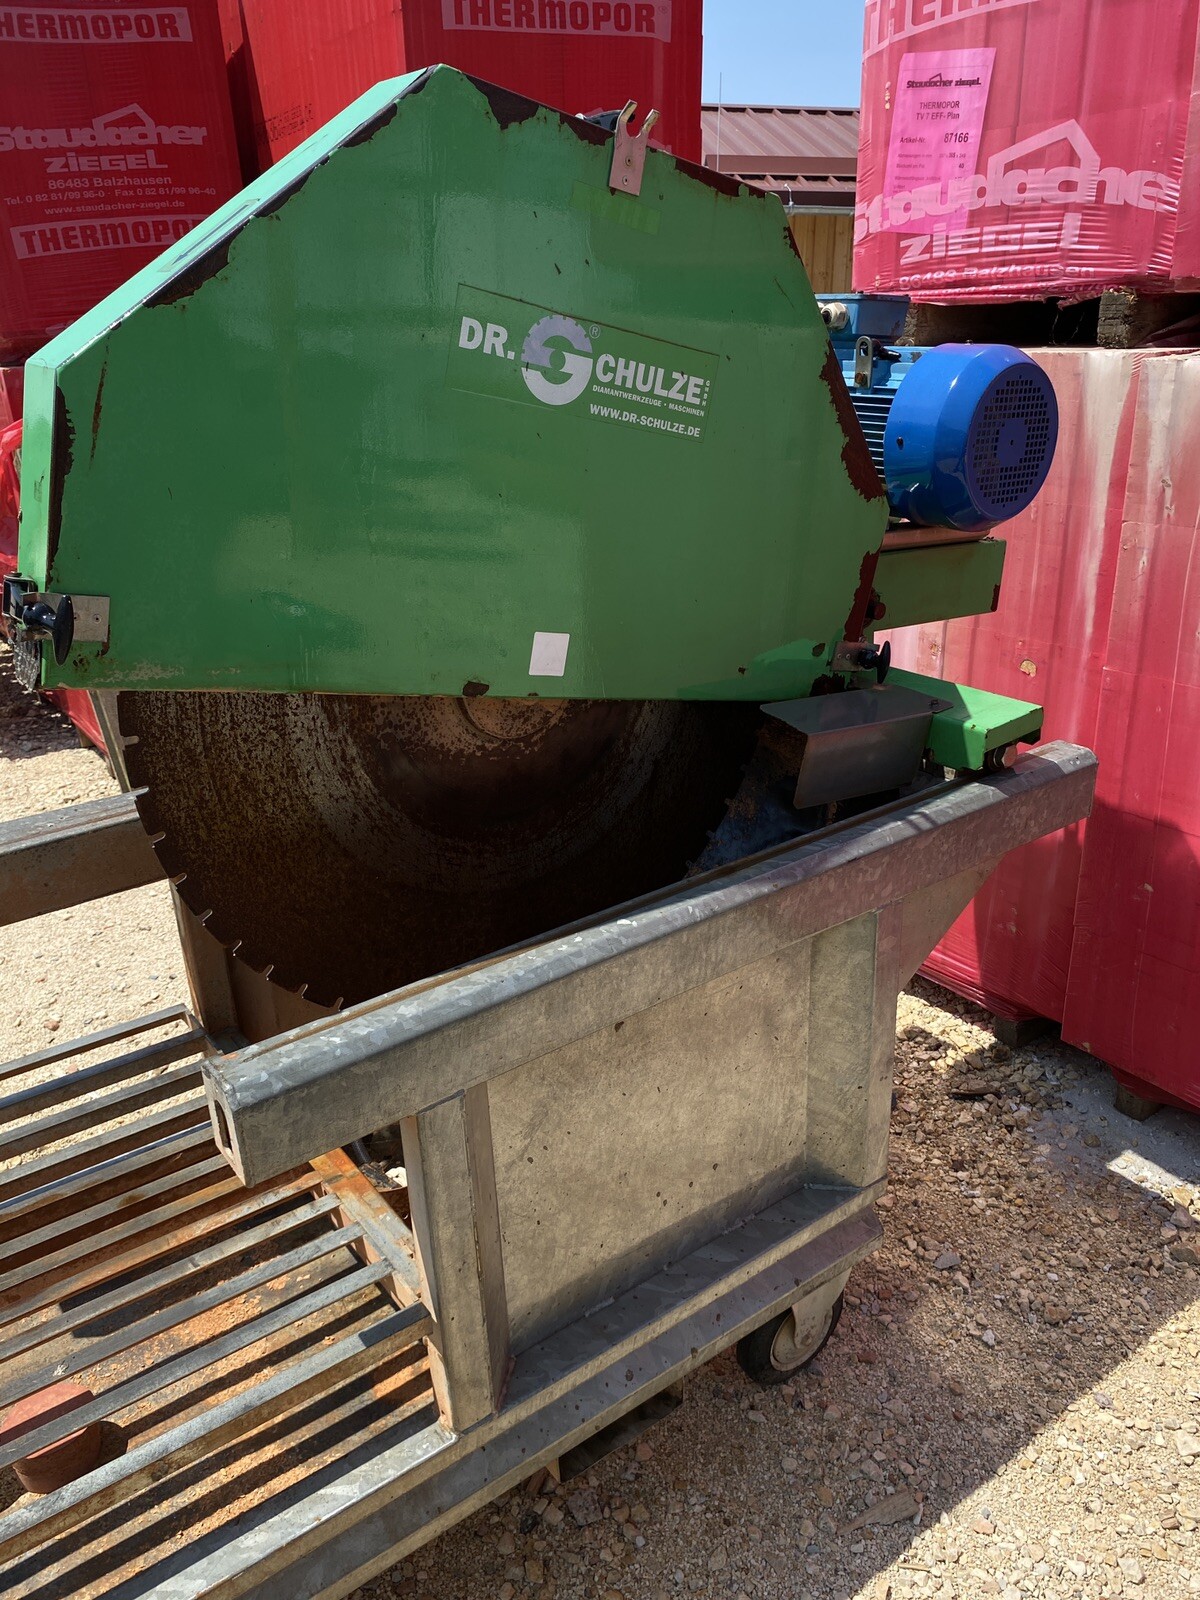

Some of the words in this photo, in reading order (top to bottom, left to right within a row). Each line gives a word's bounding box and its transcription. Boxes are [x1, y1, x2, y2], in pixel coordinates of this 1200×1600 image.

[454, 0, 656, 33] THERMOPOR
[919, 100, 960, 110] THERMOPOR
[944, 132, 969, 143] 87166
[48, 179, 89, 190] 86483
[93, 176, 172, 187] Balzhausen
[5, 197, 23, 206] Tel.
[35, 194, 48, 202] 82
[50, 192, 80, 201] 81/99
[83, 190, 105, 198] 96-0
[115, 189, 134, 197] Fax
[145, 188, 156, 196] 82
[188, 187, 216, 196] 96-40
[45, 200, 186, 215] www.staudacher-ziegel.de
[458, 316, 515, 360] DR.
[592, 384, 662, 408] DIAMANTWERKZEUGE
[668, 402, 705, 417] MASCHINEN
[590, 403, 701, 438] WWW.DR-SCHULZE.DE
